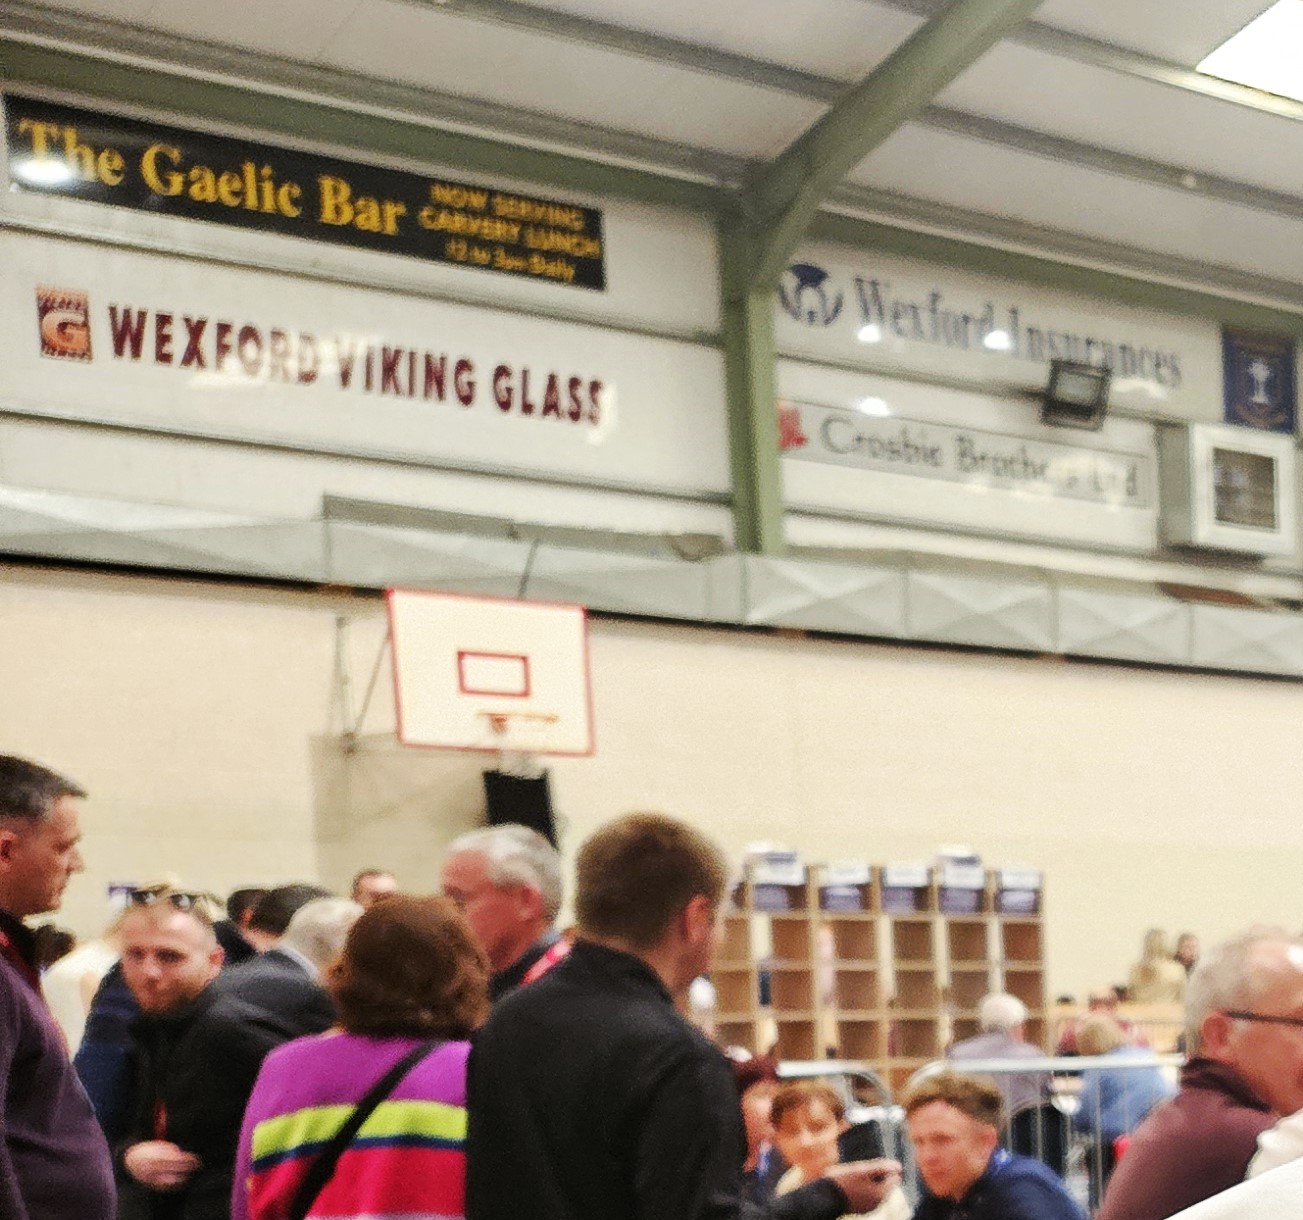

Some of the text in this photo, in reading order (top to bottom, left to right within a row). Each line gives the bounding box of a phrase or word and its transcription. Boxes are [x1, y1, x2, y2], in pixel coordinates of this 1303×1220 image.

[19, 118, 406, 237] The Gaelic Bar
[108, 303, 603, 426] WEXFORD VIKING GLASS
